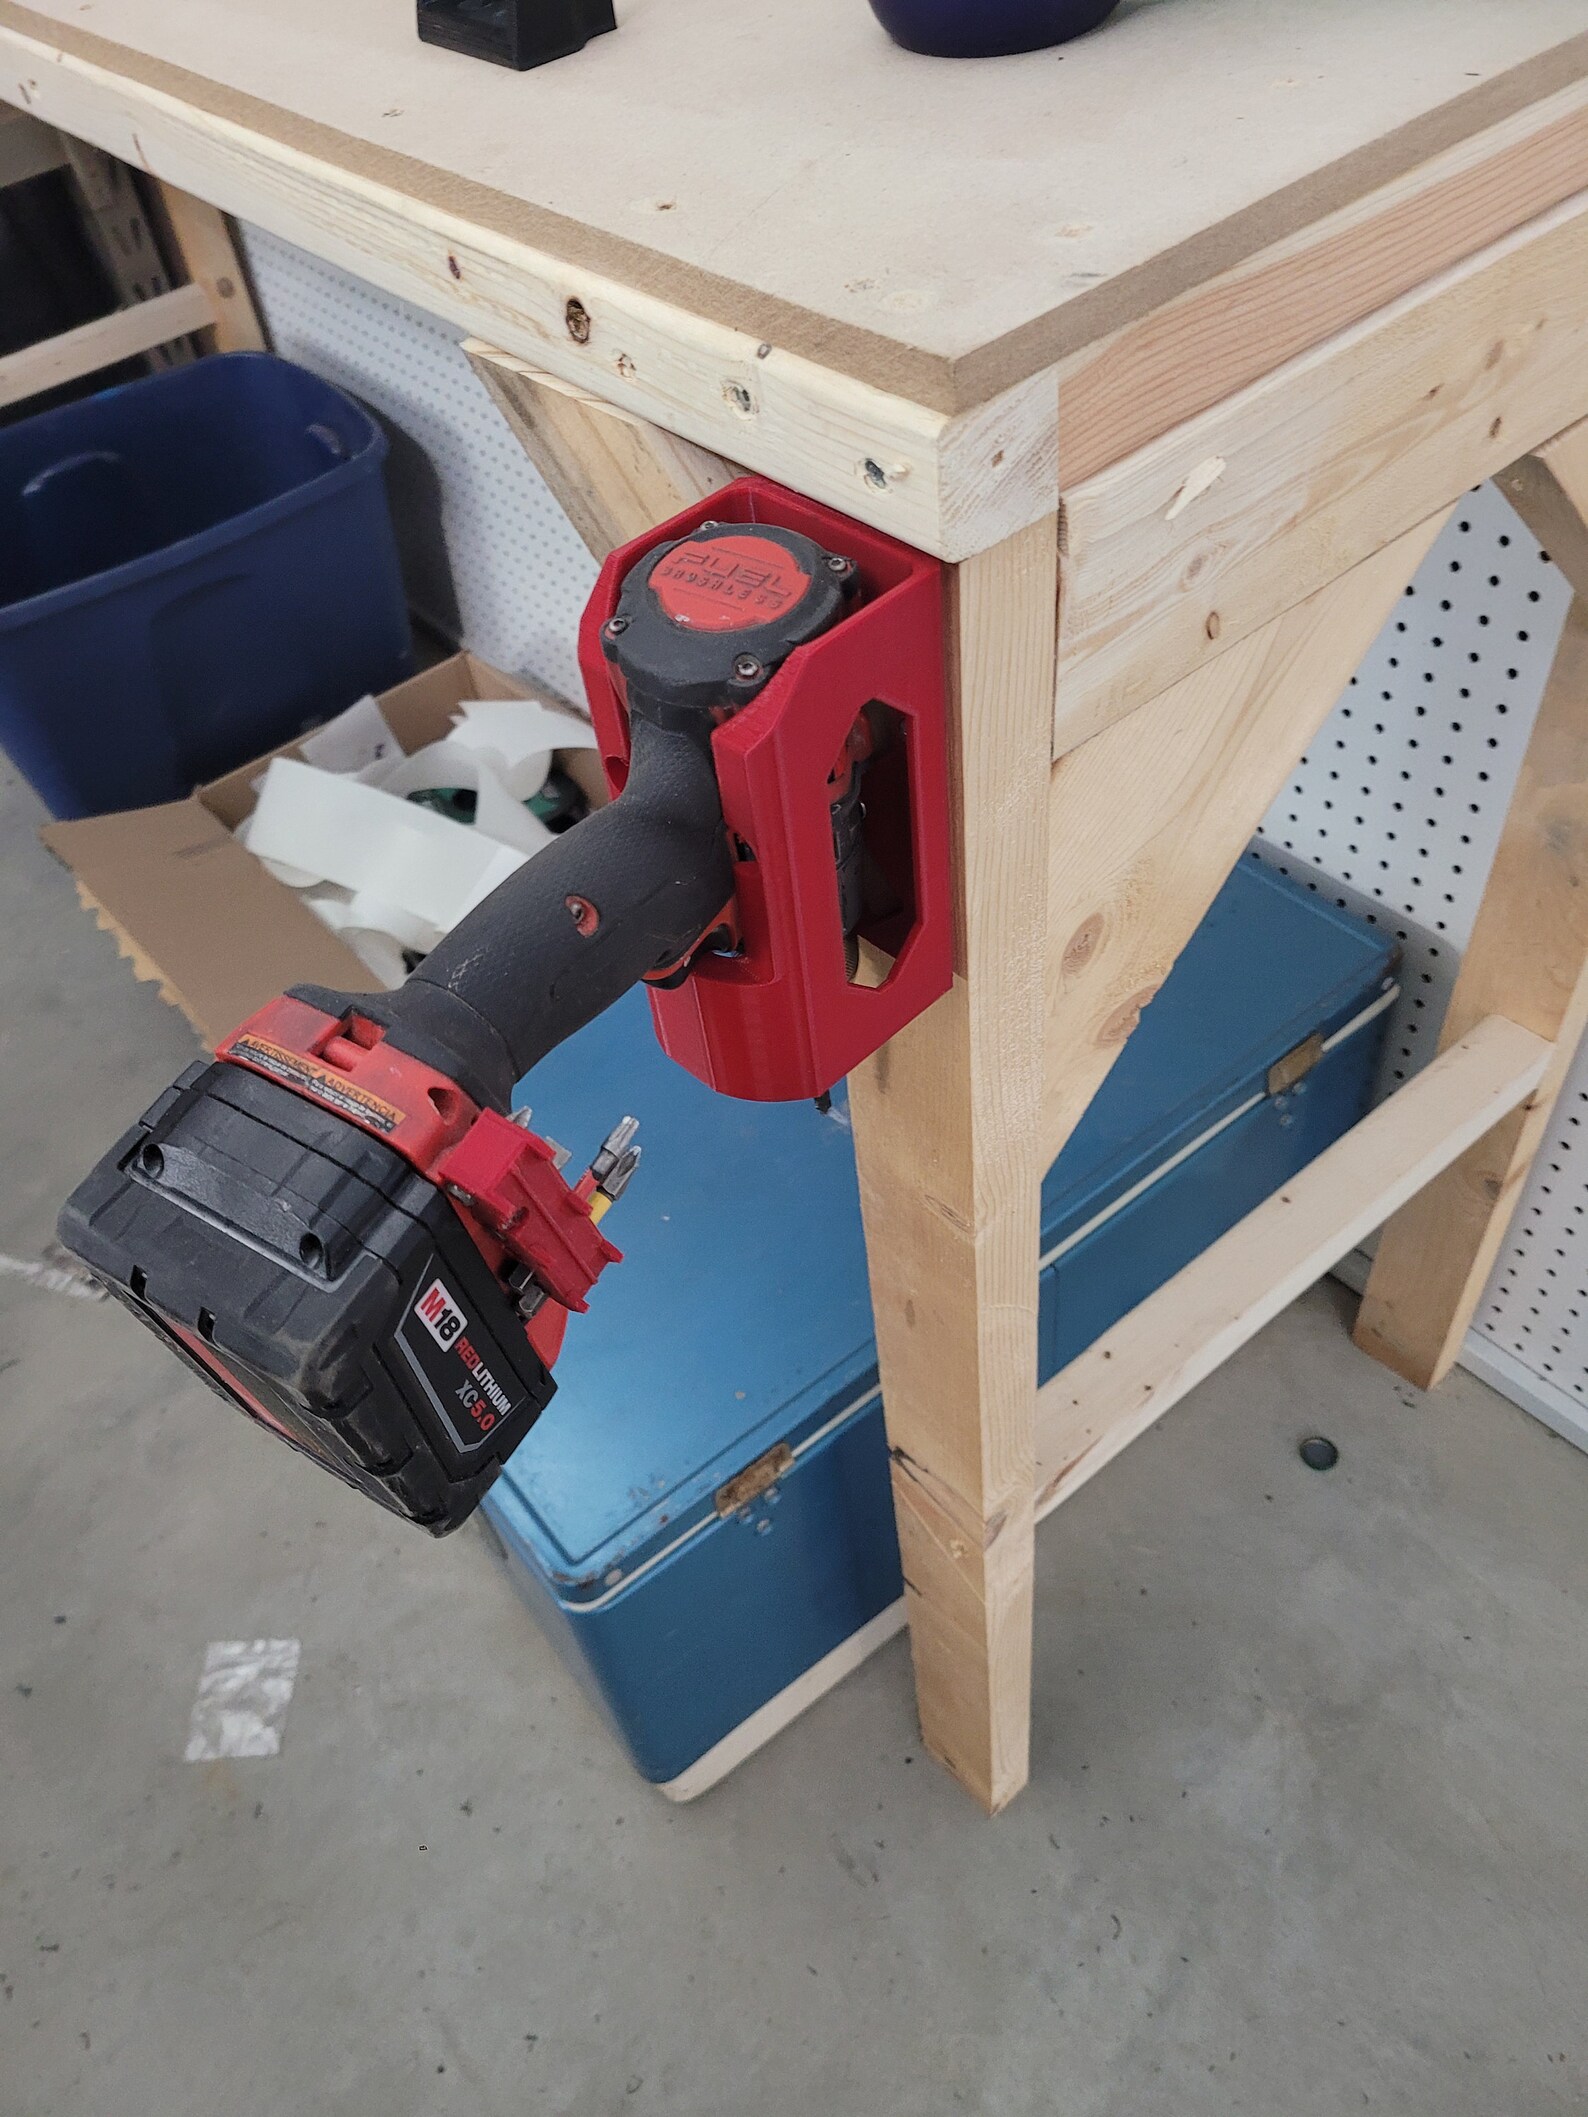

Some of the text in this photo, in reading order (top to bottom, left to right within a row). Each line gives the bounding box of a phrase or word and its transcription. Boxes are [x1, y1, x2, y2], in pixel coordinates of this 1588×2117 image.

[674, 553, 791, 596] FUEL
[327, 1079, 396, 1120] ADVERTENCIA
[421, 1287, 461, 1341] M18
[453, 1336, 512, 1416] REDLITHIUM
[455, 1379, 495, 1431] XC5.0
